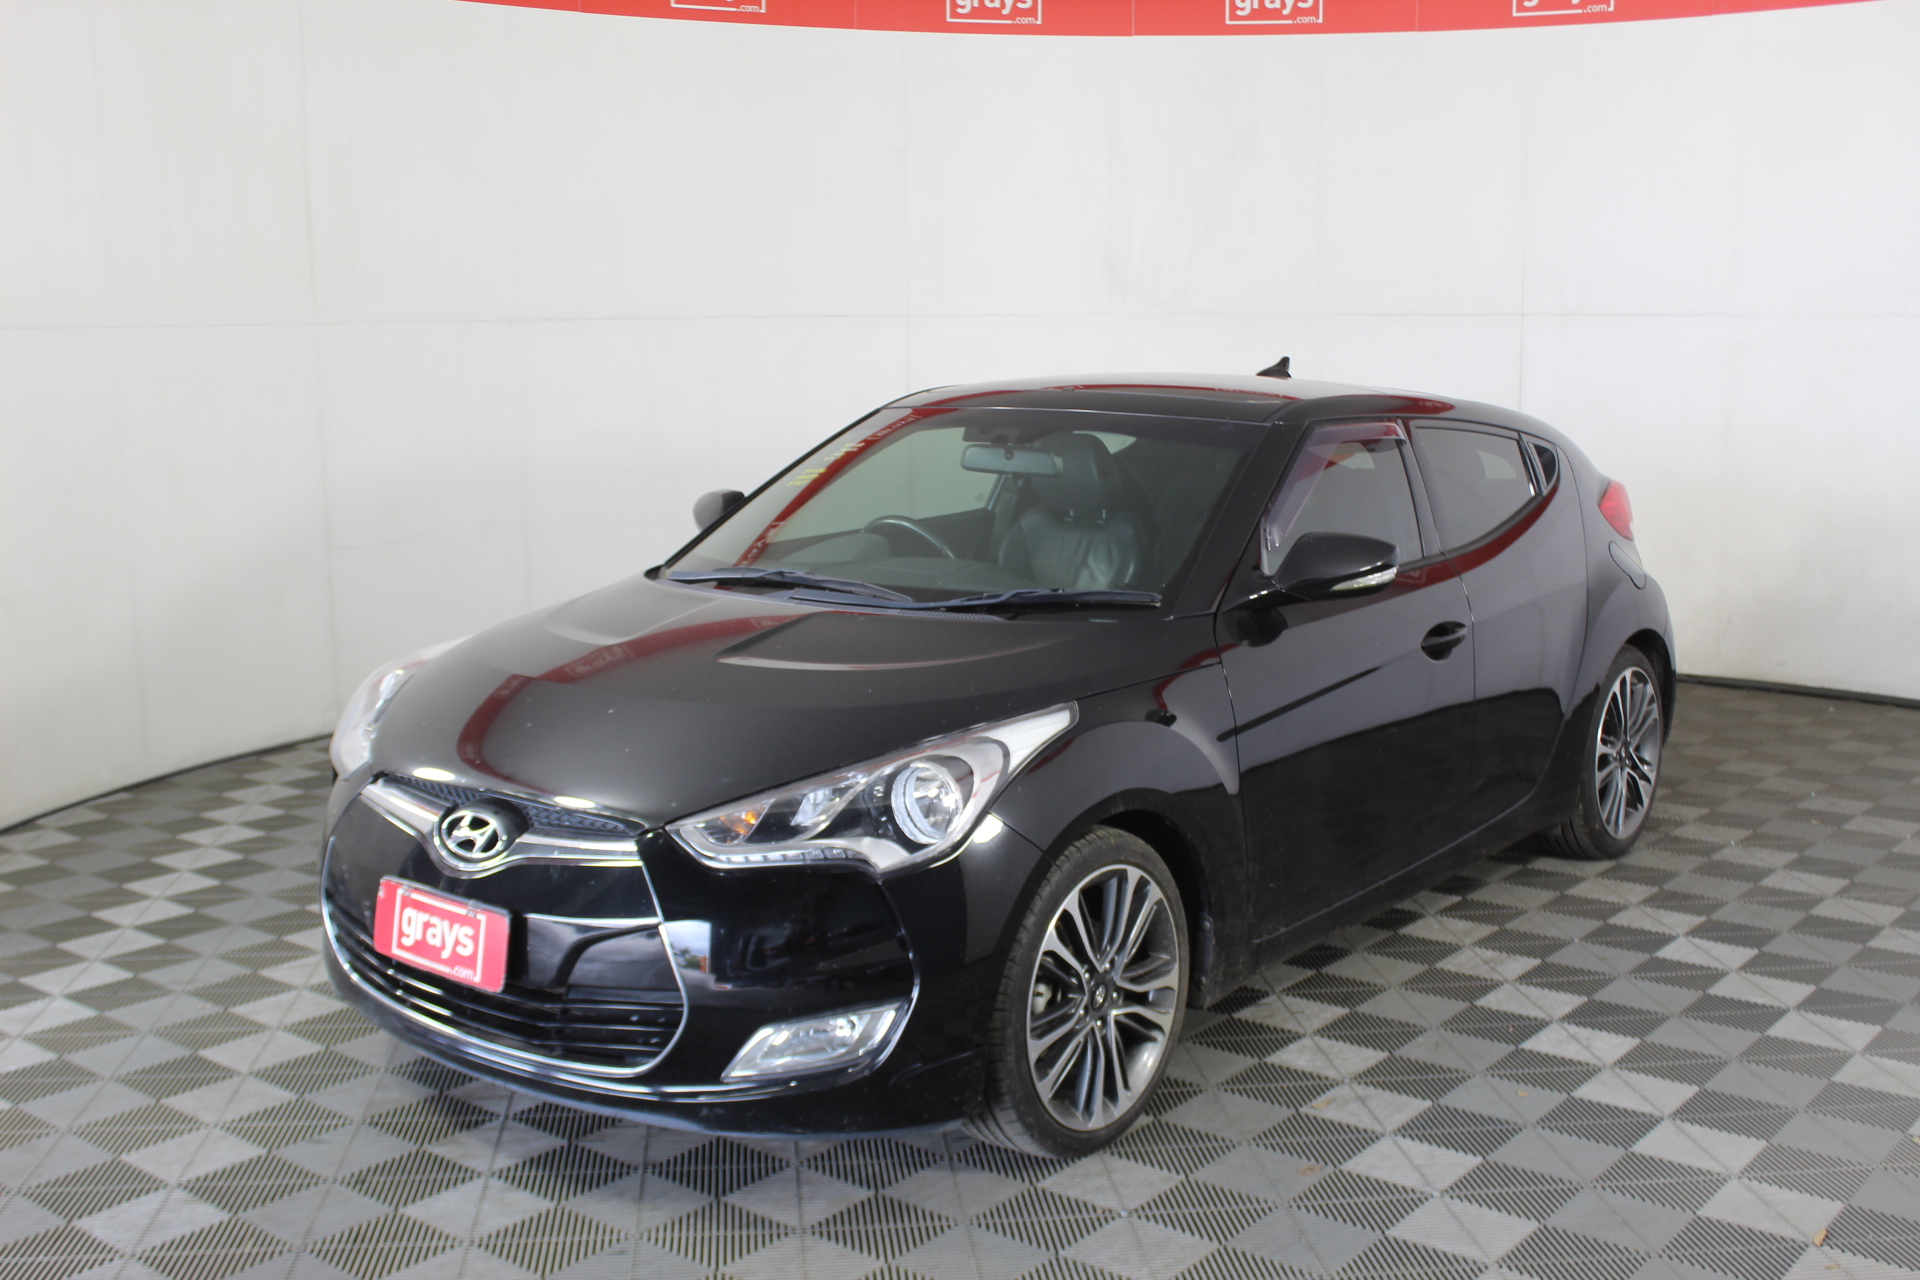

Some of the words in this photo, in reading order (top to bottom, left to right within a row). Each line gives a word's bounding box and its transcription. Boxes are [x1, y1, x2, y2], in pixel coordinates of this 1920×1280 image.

[1583, 4, 1608, 13] .com
[1013, 17, 1036, 25] .com
[1293, 16, 1317, 24] .com
[401, 907, 475, 959] grays
[450, 965, 475, 981] .com
